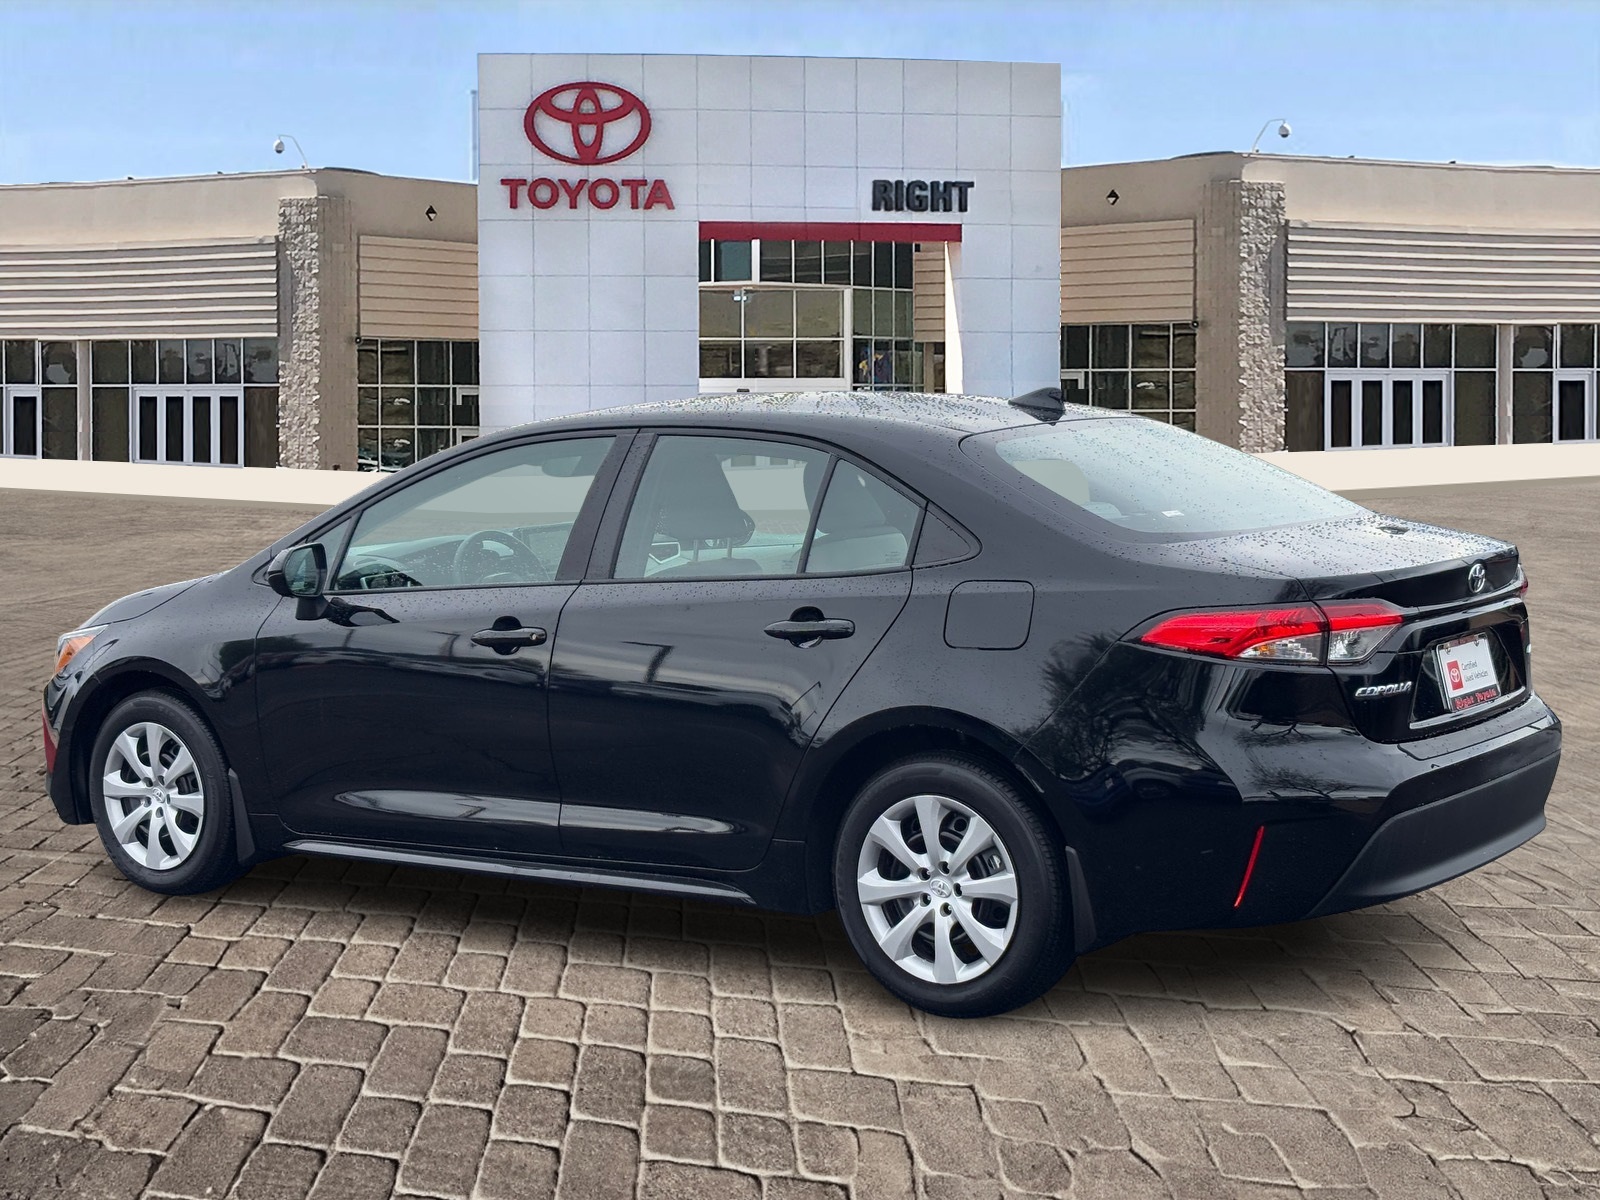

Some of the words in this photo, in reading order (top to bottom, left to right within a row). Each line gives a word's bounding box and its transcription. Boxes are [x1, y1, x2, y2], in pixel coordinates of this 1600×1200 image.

[500, 177, 675, 210] TOYOTA
[872, 179, 974, 212] RIGHT
[1462, 660, 1477, 671] Certified
[1474, 670, 1488, 680] Vehicles
[1355, 681, 1412, 697] COROLLA
